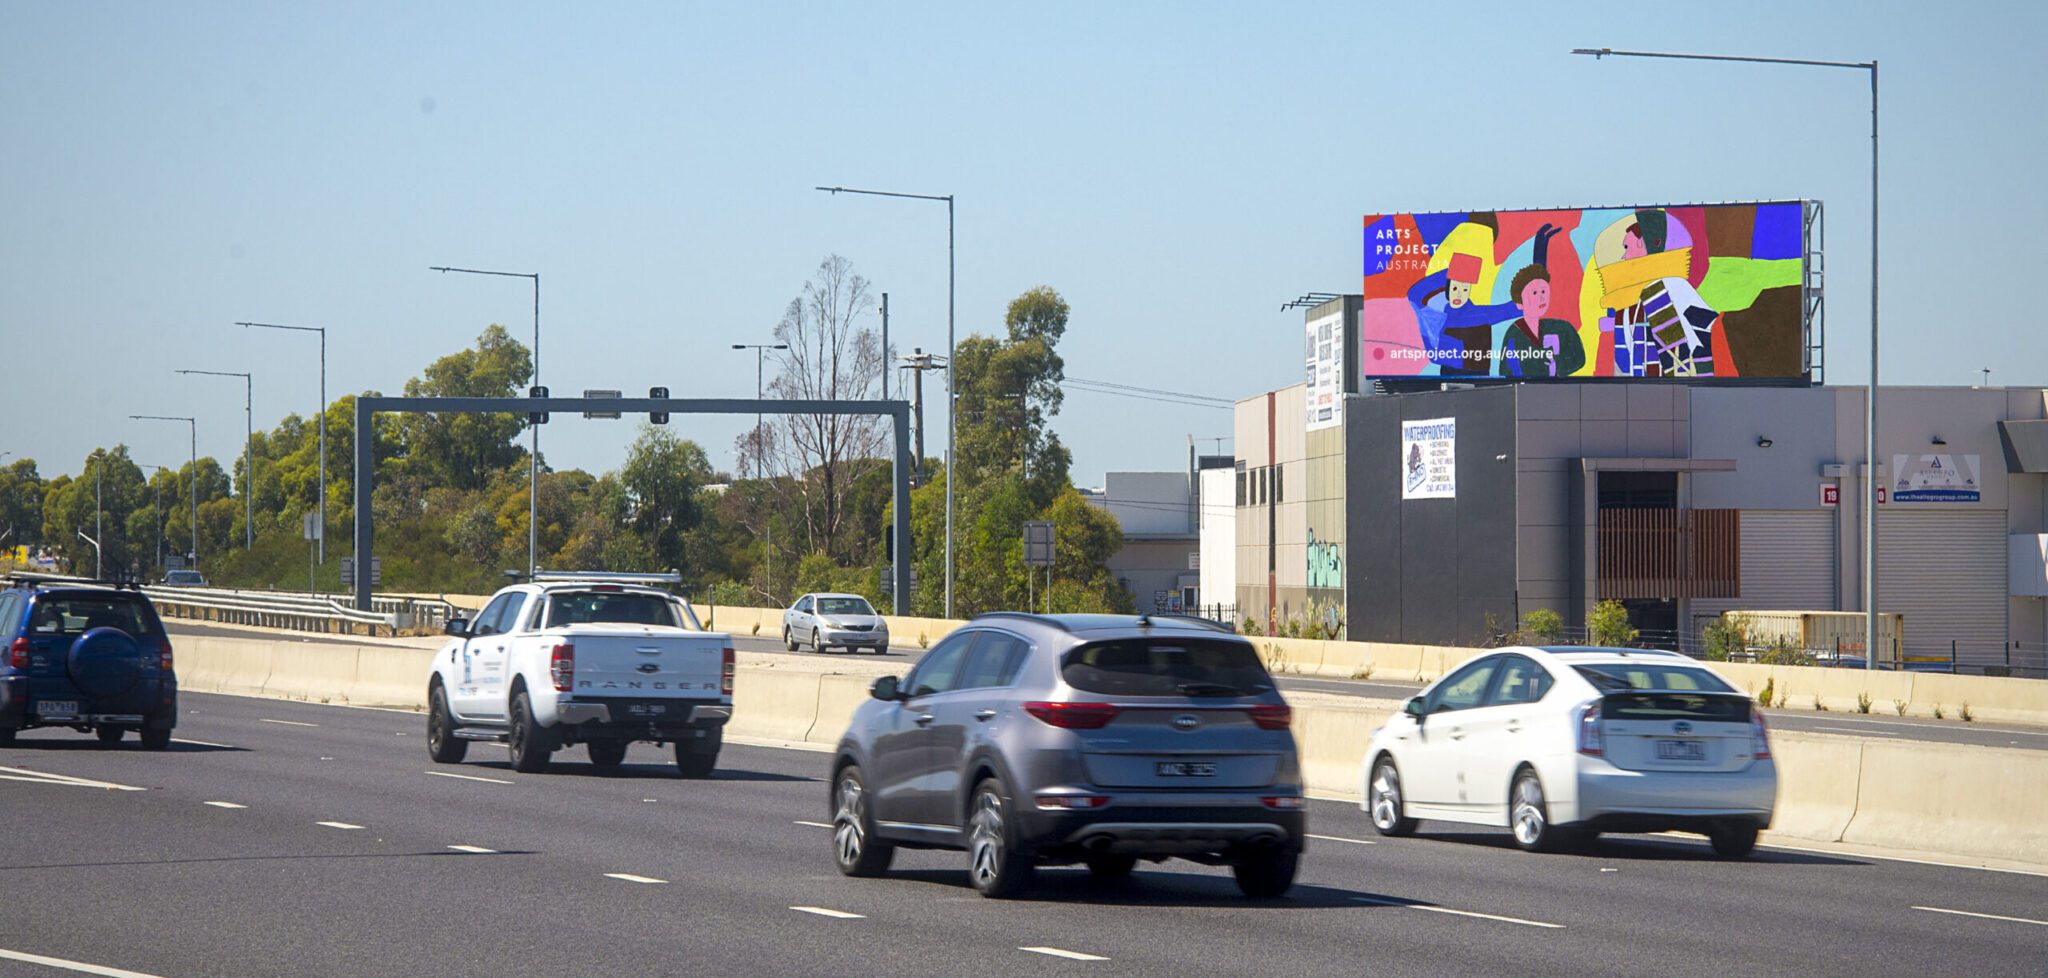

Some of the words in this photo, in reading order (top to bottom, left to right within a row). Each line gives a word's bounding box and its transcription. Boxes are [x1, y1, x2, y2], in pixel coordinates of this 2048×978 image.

[1376, 228, 1411, 239] ARTS
[1376, 243, 1439, 255] PROJECT
[1376, 259, 1449, 271] AUSTRALIA
[1390, 346, 1554, 361] artsproject.org.au/explore
[1404, 423, 1455, 441] WATERPROOFING
[1827, 490, 1837, 501] 19
[579, 680, 717, 690] RANGER
